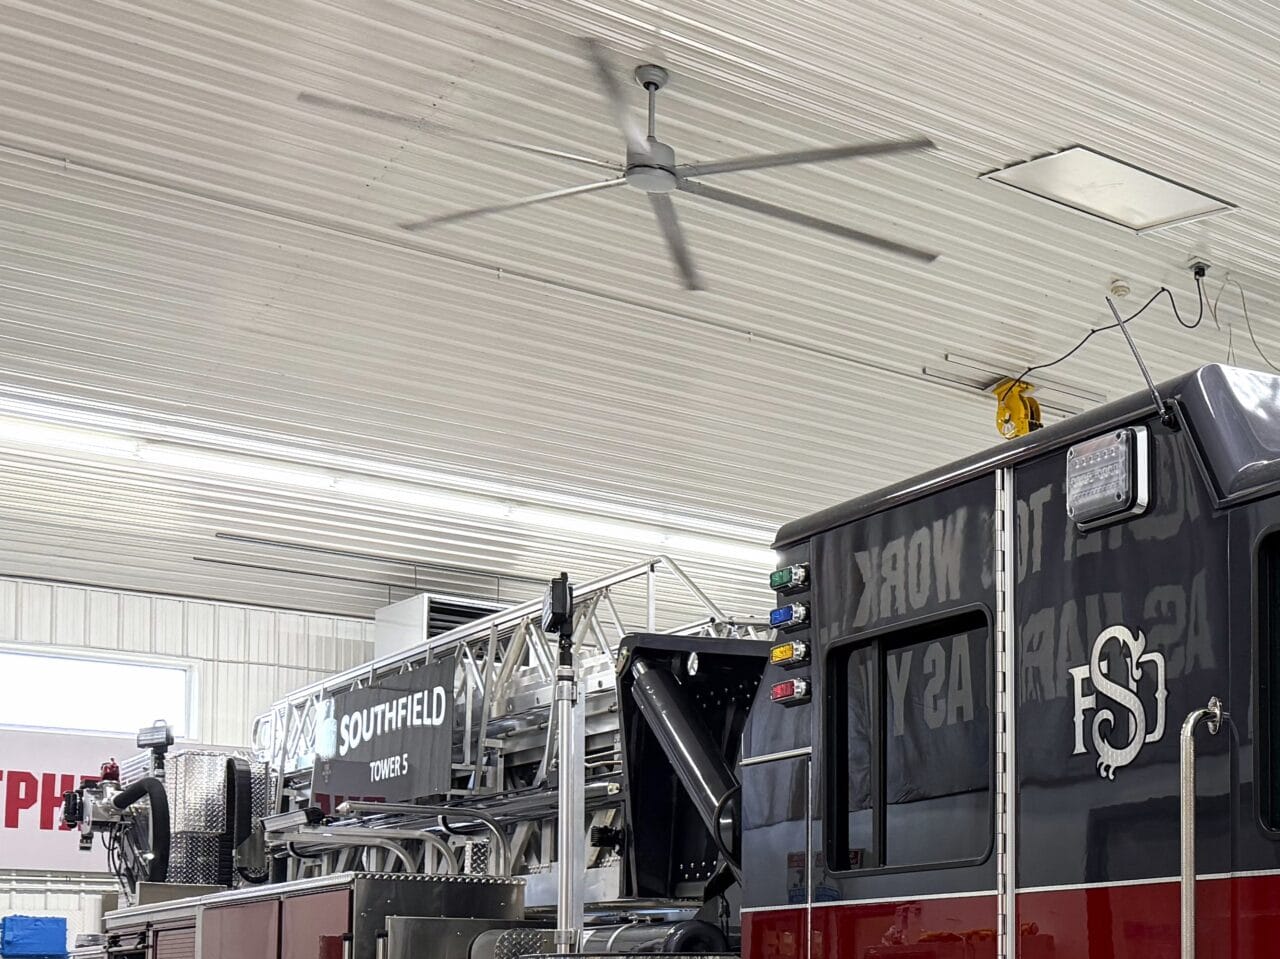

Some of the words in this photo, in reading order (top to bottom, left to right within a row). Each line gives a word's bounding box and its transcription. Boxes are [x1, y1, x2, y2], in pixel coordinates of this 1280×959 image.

[339, 686, 446, 756] SOUTHFIELD
[370, 755, 401, 783] TOWER
[402, 753, 408, 775] 5
